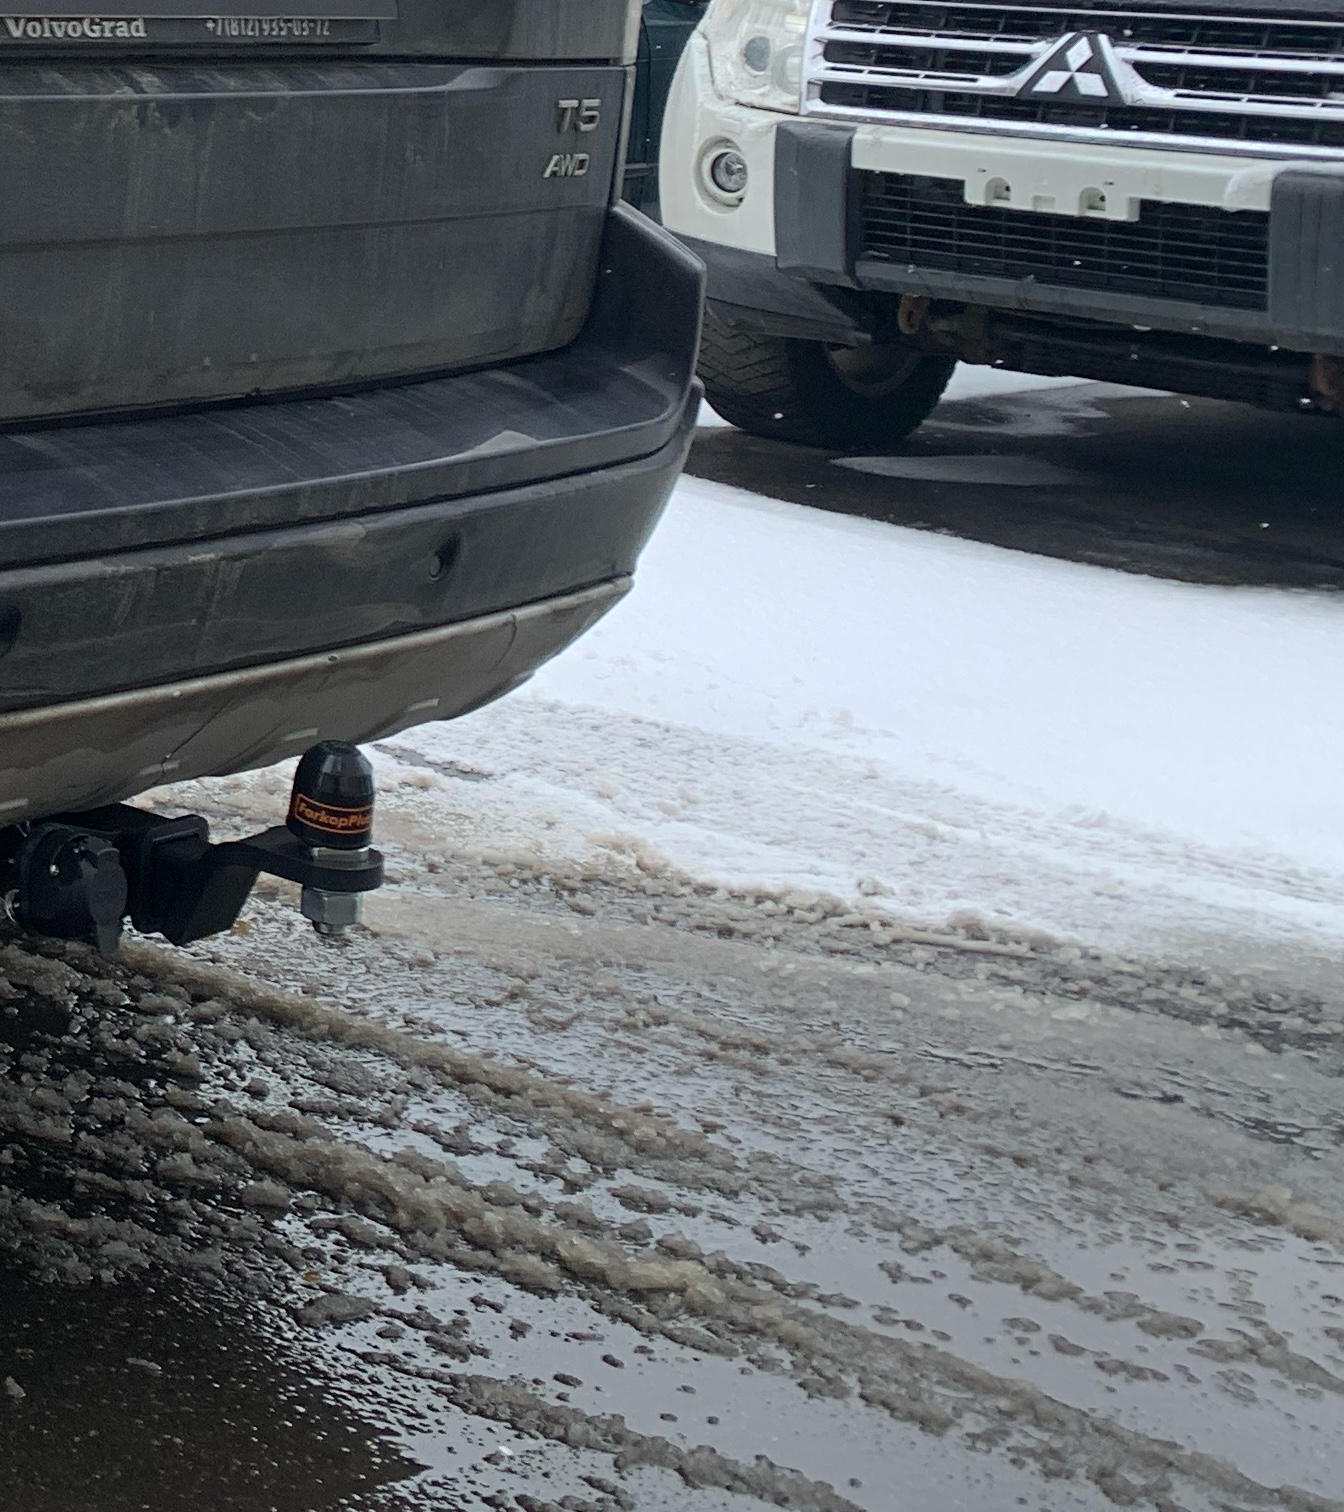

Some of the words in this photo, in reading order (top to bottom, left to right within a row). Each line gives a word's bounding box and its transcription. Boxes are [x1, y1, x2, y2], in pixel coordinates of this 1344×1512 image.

[5, 17, 148, 38] VolvoGrad
[557, 98, 602, 134] T5
[543, 153, 590, 178] AWD
